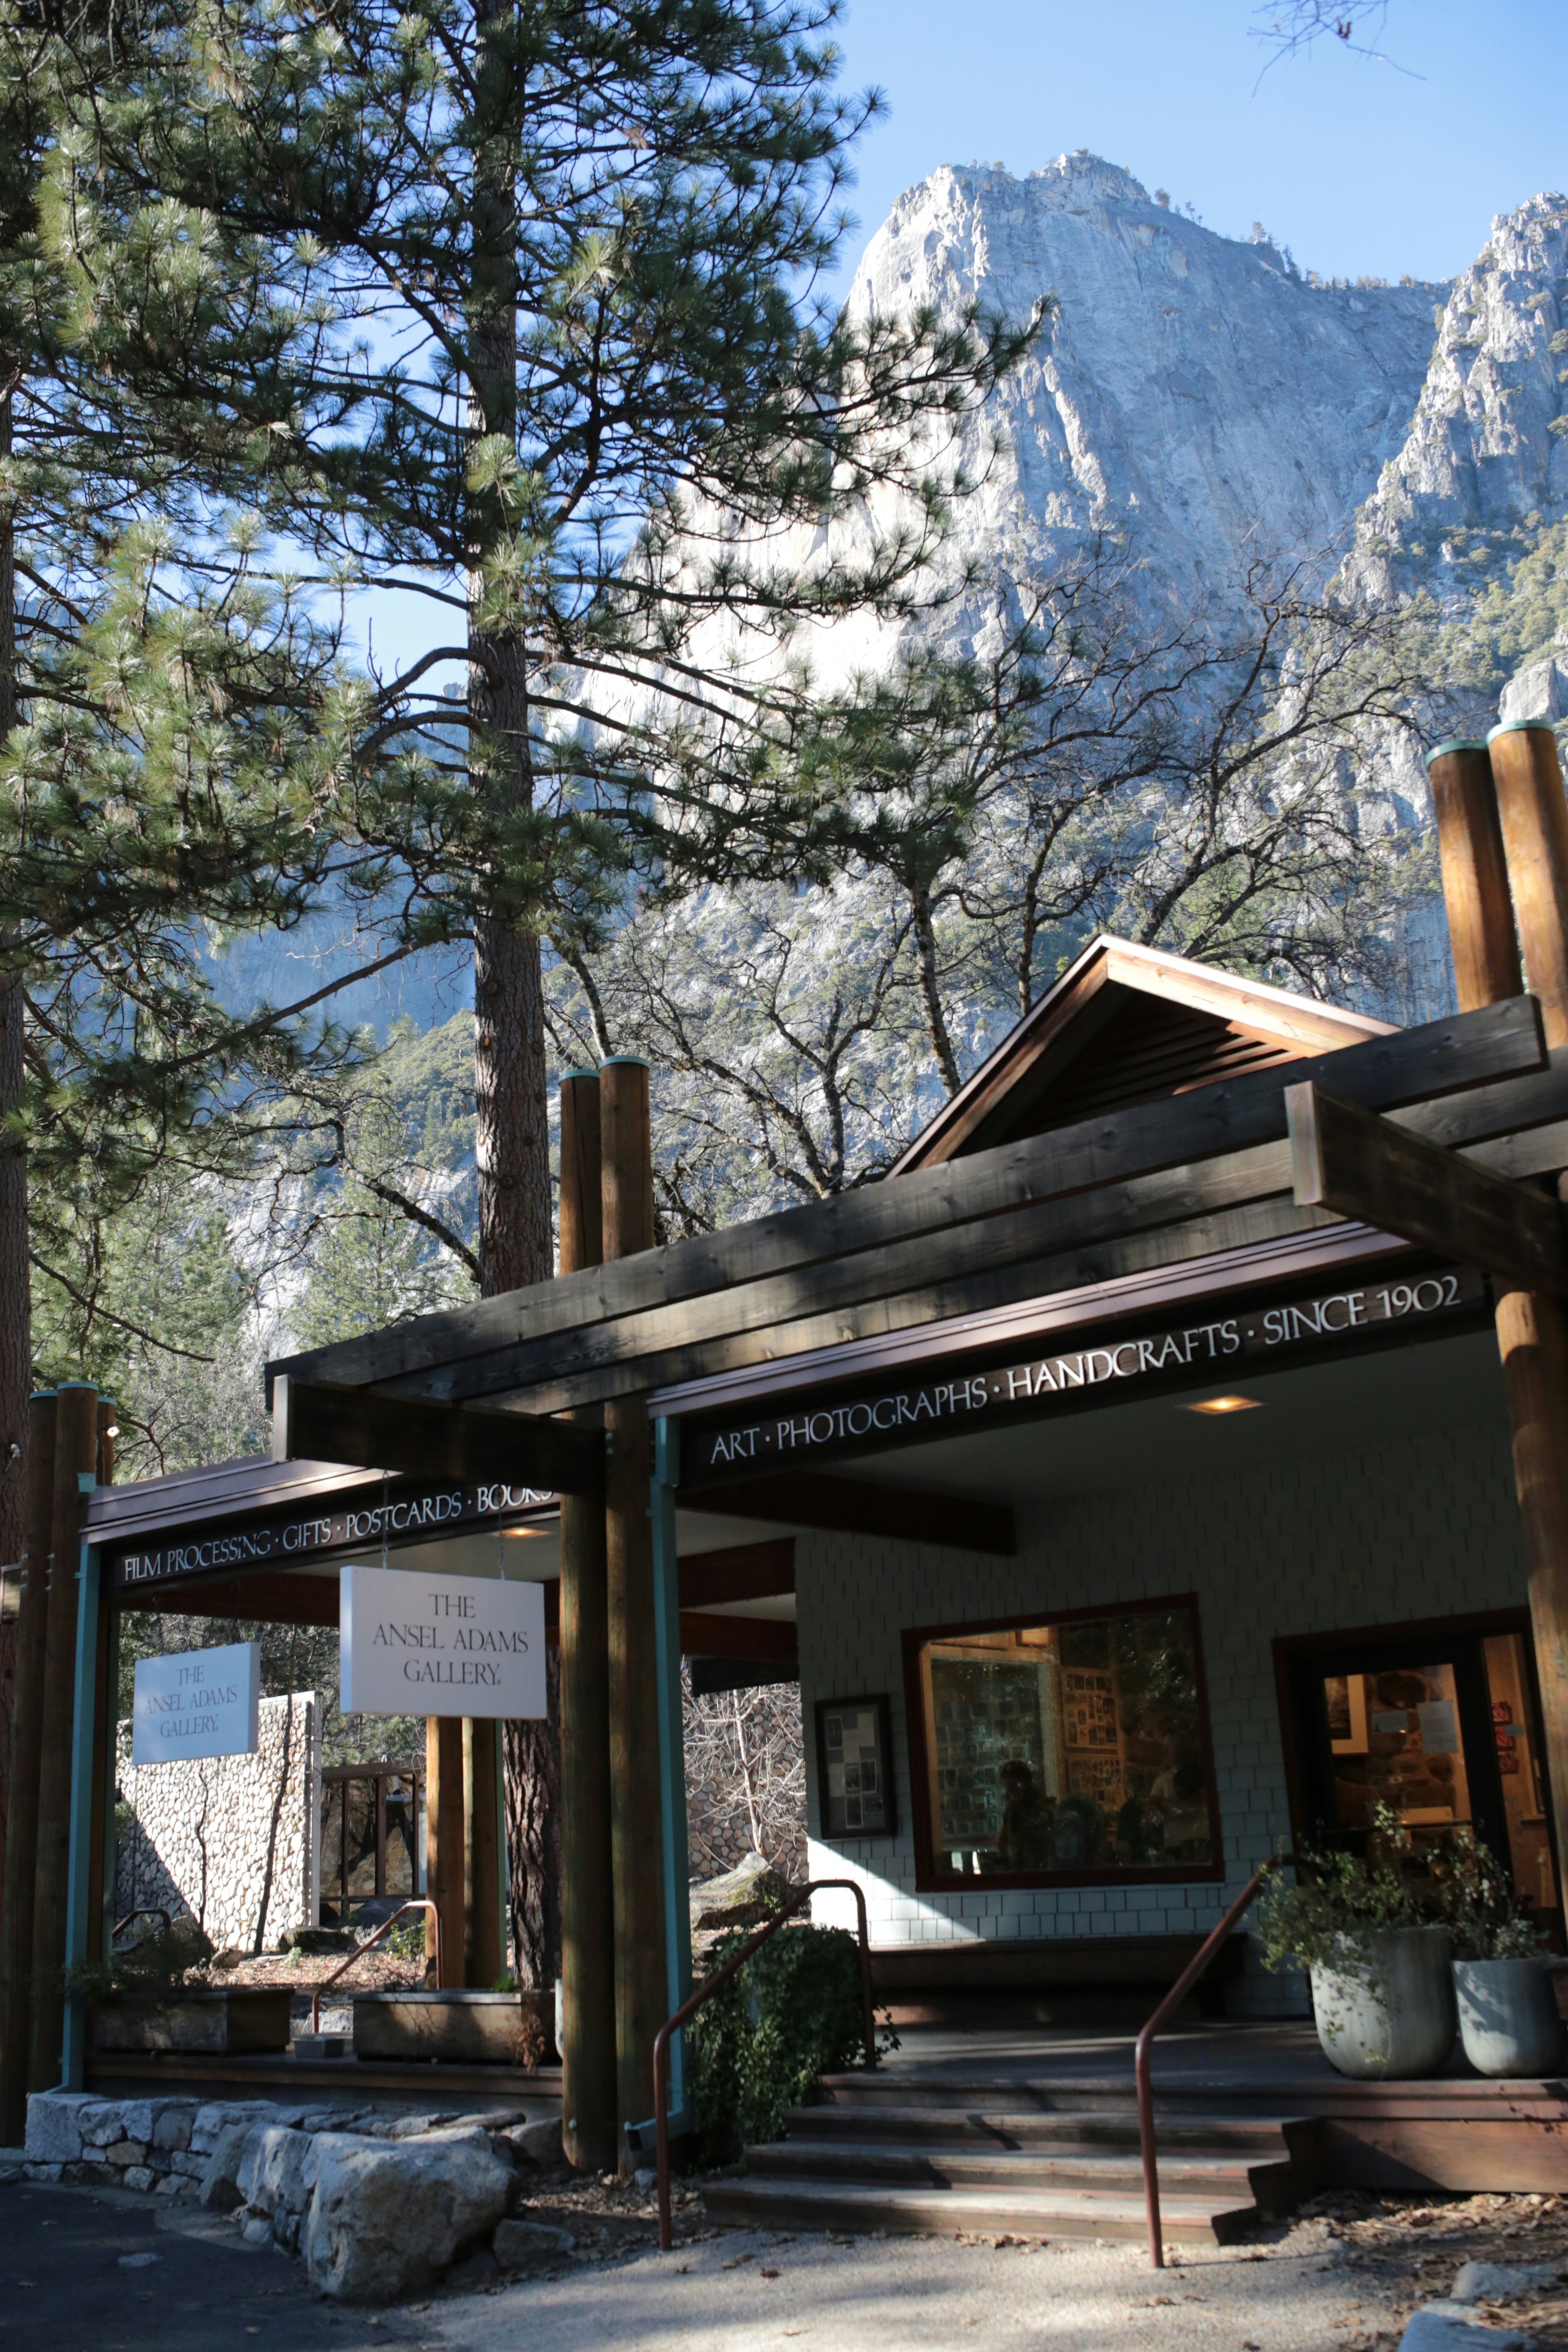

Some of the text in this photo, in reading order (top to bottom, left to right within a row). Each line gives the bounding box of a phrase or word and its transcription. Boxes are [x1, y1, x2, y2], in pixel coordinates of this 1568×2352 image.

[710, 1275, 1461, 1464] ART PHOTOGRAPHS HANDCRAFTS SINCE 1902
[125, 1552, 162, 1581] FILM
[167, 1530, 271, 1573] PROCESSING
[283, 1518, 332, 1550] GIFTS
[346, 1491, 462, 1539] POSTCARDS
[429, 1594, 475, 1618] THE
[373, 1624, 528, 1653] ANSEL ADAMS
[177, 1665, 205, 1685] THE
[145, 1685, 237, 1715] ANSEL ADAMS
